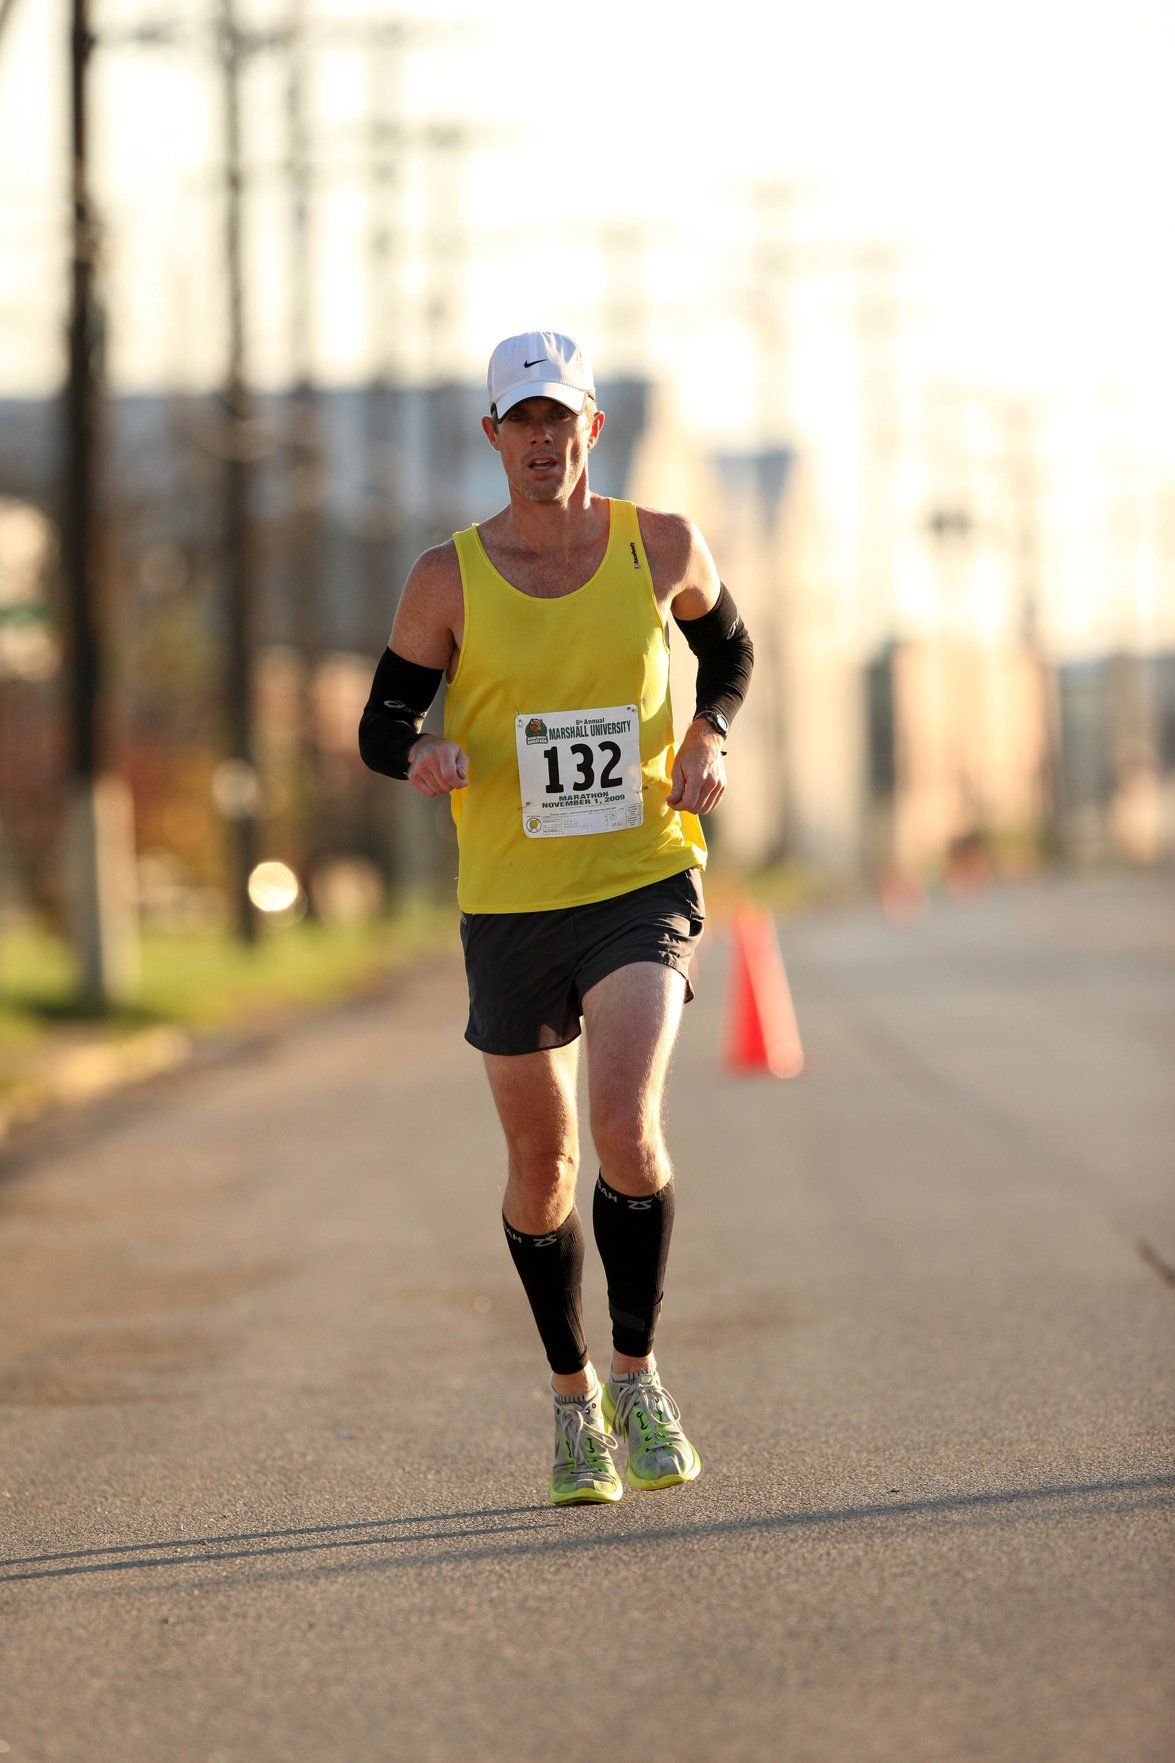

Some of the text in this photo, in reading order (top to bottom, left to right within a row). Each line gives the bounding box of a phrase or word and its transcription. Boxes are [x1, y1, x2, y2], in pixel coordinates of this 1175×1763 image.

[584, 717, 605, 725] Annual
[549, 720, 631, 740] MARSHALL UNIVERSITY
[543, 740, 623, 794] 132
[541, 799, 591, 809] NOVEMBER
[604, 794, 626, 803] 2009
[559, 791, 609, 802] MARATHON
